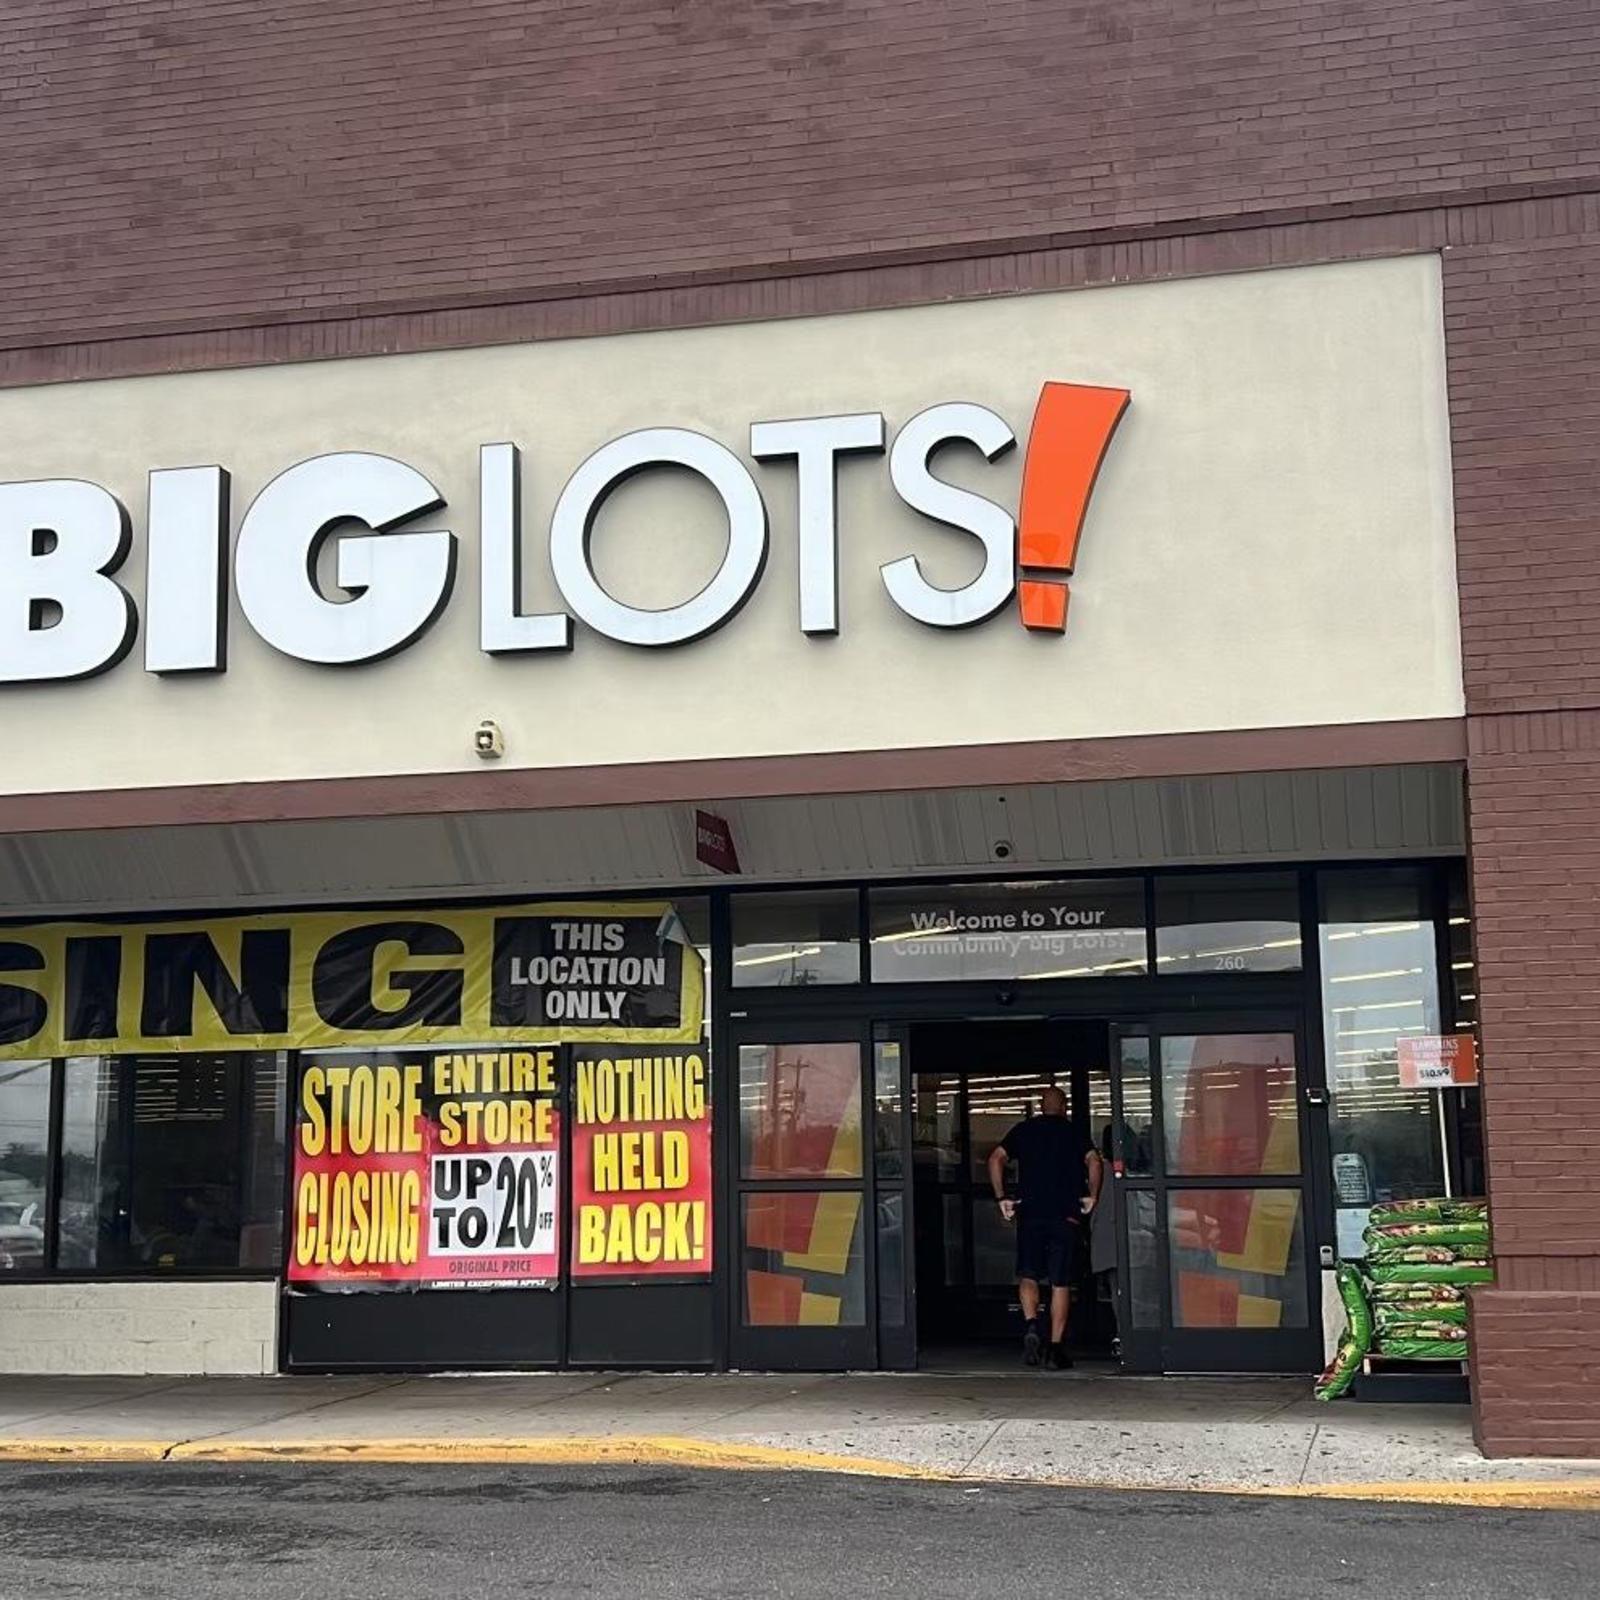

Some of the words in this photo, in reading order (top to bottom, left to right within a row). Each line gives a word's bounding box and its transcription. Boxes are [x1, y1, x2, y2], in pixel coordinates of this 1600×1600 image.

[551, 922, 625, 951] THIS
[911, 909, 1016, 930] Welcome
[1021, 910, 1045, 927] to
[1050, 906, 1105, 926] Your
[510, 956, 666, 986] LOCATION
[1214, 956, 1244, 970] 260
[545, 990, 627, 1019] ONLY
[433, 1051, 555, 1095] ENTIRE
[575, 1054, 706, 1124] NOTHING
[301, 1065, 422, 1156] STORE
[439, 1099, 554, 1146] STORE
[433, 1158, 492, 1201] UP
[593, 1130, 689, 1192] HELD
[296, 1169, 420, 1266] CLOSING
[432, 1207, 489, 1249] TO
[539, 1212, 554, 1230] OFF
[578, 1201, 705, 1264] BACK!
[449, 1260, 498, 1274] ORIGINAL
[502, 1260, 532, 1273] PRICE
